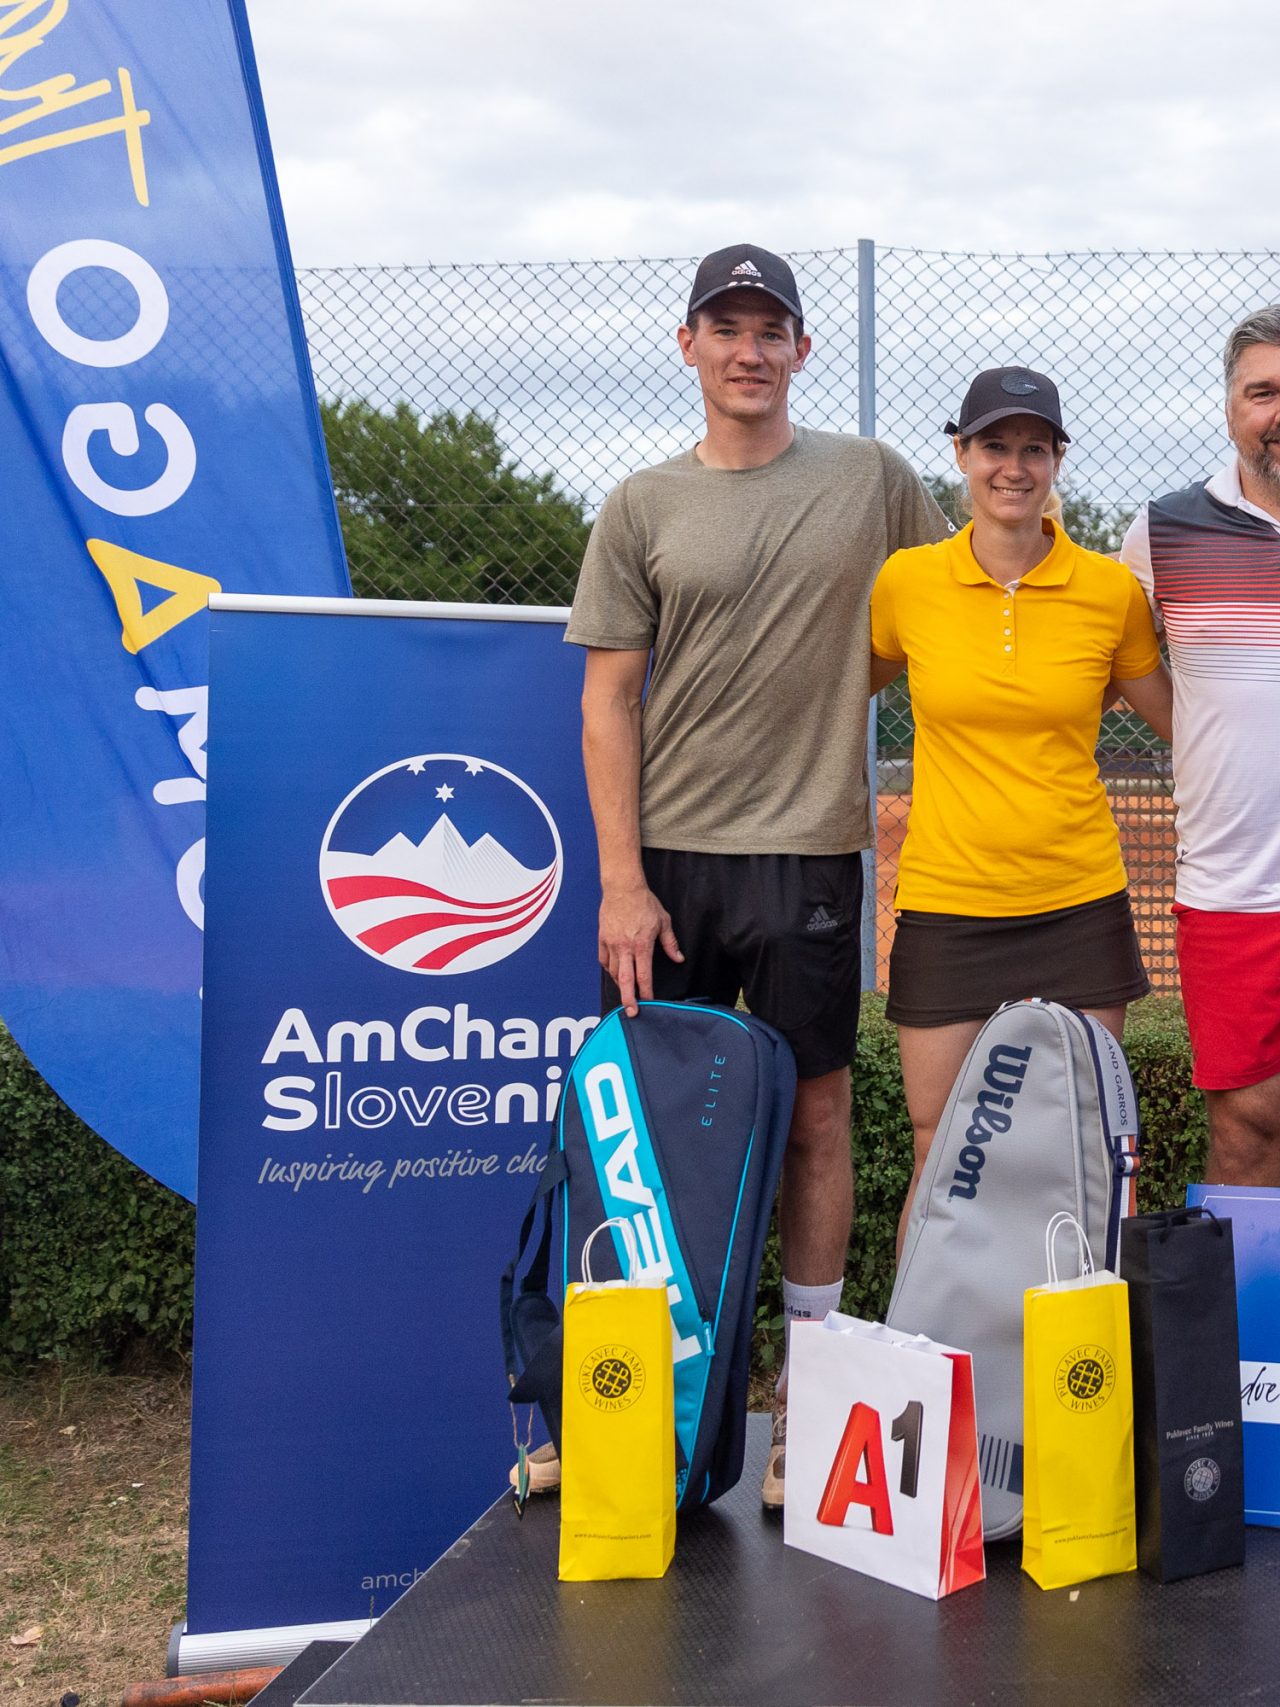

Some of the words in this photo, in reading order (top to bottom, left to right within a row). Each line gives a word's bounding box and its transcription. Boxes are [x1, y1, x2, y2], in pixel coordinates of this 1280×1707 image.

[731, 269, 762, 277] adidas
[807, 920, 838, 931] adidas
[261, 1003, 601, 1064] AmCham
[701, 1054, 726, 1127] ELITE
[1115, 1074, 1128, 1126] GARROS
[947, 1043, 1033, 1203] Wilson
[258, 1153, 386, 1194] Inspiring
[389, 1148, 499, 1188] positive
[581, 1347, 618, 1393] PUKLAVEC
[622, 1350, 643, 1391] FAMILY
[1057, 1347, 1090, 1398] PUKLAVEC
[1094, 1349, 1114, 1389] FAMILY
[1240, 1365, 1280, 1406] dve
[594, 1396, 632, 1410] WINES
[1070, 1394, 1105, 1411] WINES
[1166, 1428, 1192, 1440] Puklavec
[1193, 1422, 1213, 1433] Family
[1214, 1420, 1234, 1429] Wines
[815, 1401, 924, 1537] A1
